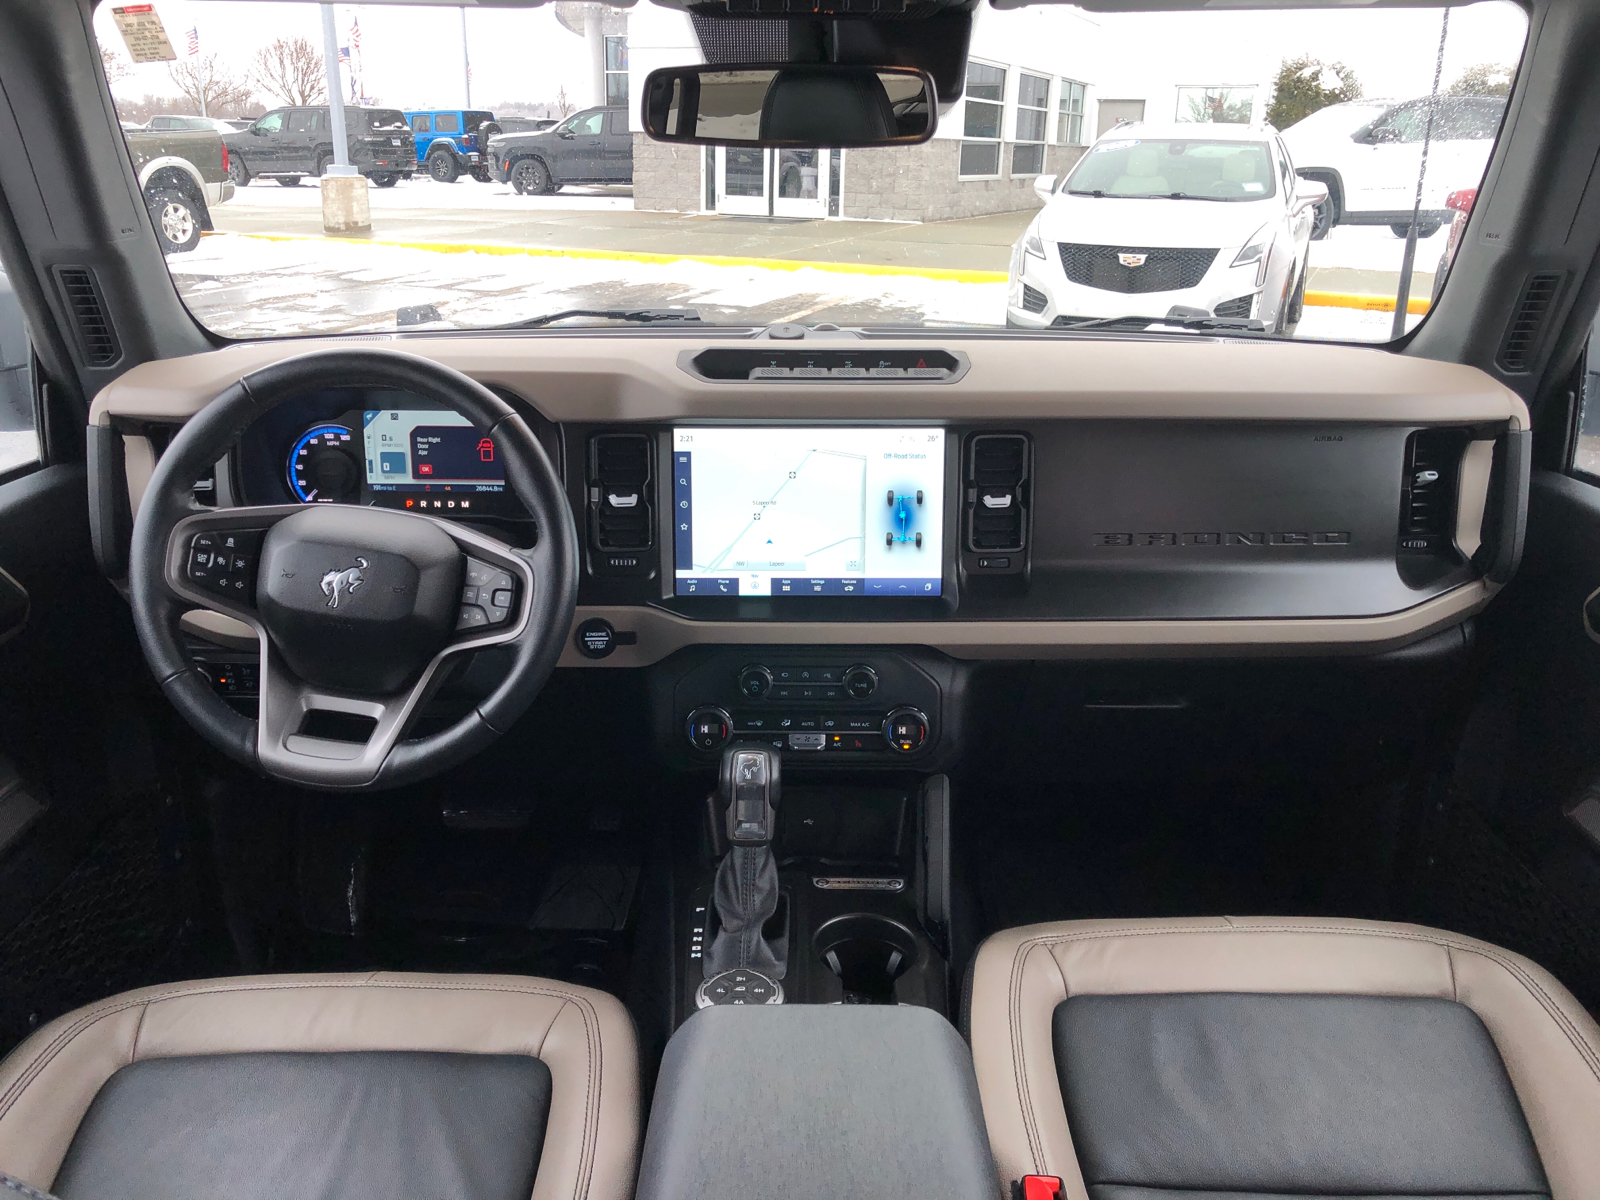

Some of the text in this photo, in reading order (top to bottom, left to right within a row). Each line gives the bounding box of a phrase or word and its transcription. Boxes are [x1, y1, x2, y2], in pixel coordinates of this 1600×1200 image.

[405, 500, 469, 508] P R N D M
[1093, 531, 1351, 546] BRONCO
[898, 726, 907, 735] HI
